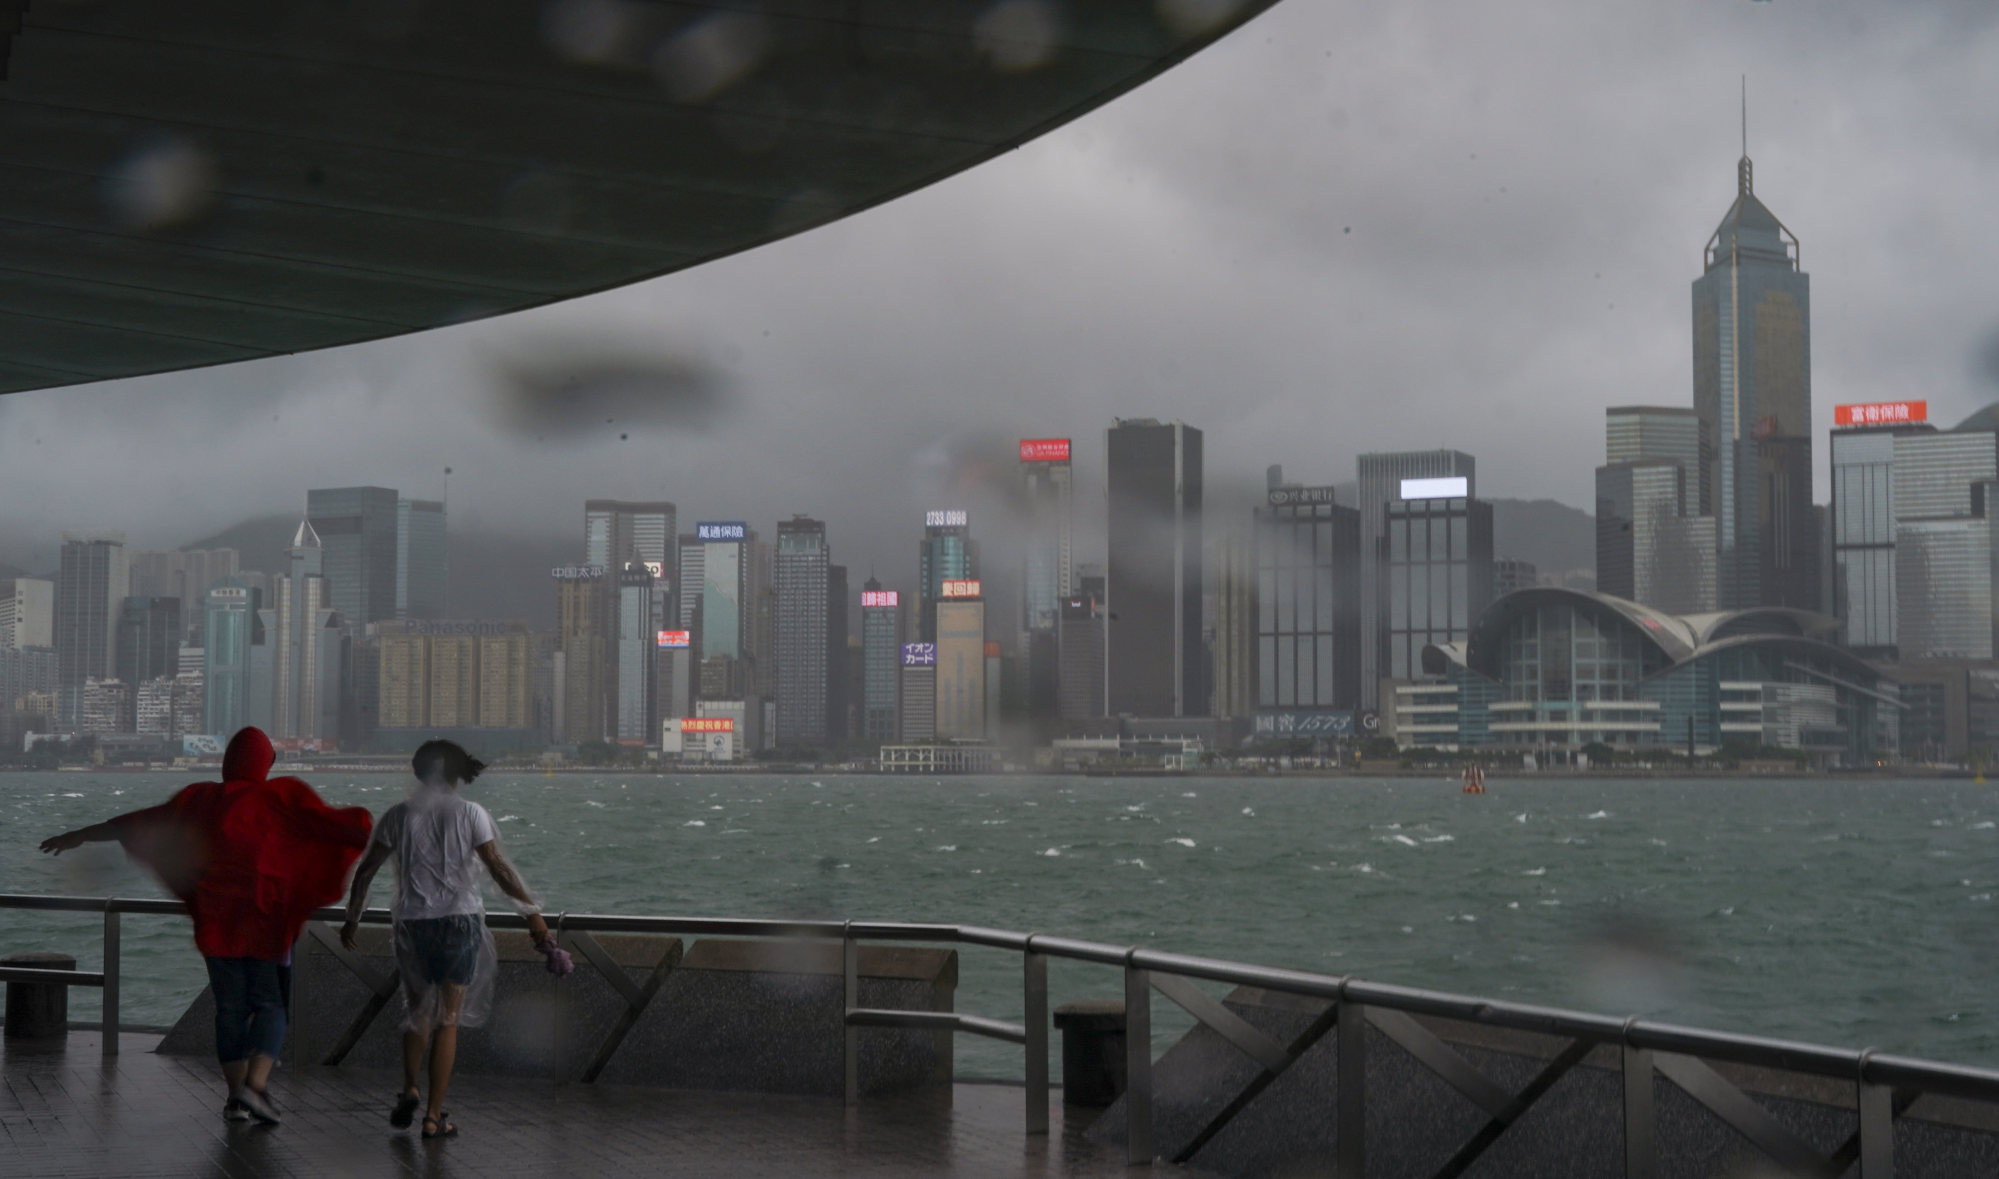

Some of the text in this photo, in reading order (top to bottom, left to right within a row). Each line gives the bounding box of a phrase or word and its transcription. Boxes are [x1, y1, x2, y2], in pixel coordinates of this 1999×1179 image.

[926, 511, 944, 526] 2733
[698, 525, 744, 539] 萬通保險
[405, 620, 505, 634] Panasonic
[905, 643, 934, 654] イオン
[905, 653, 934, 665] カード
